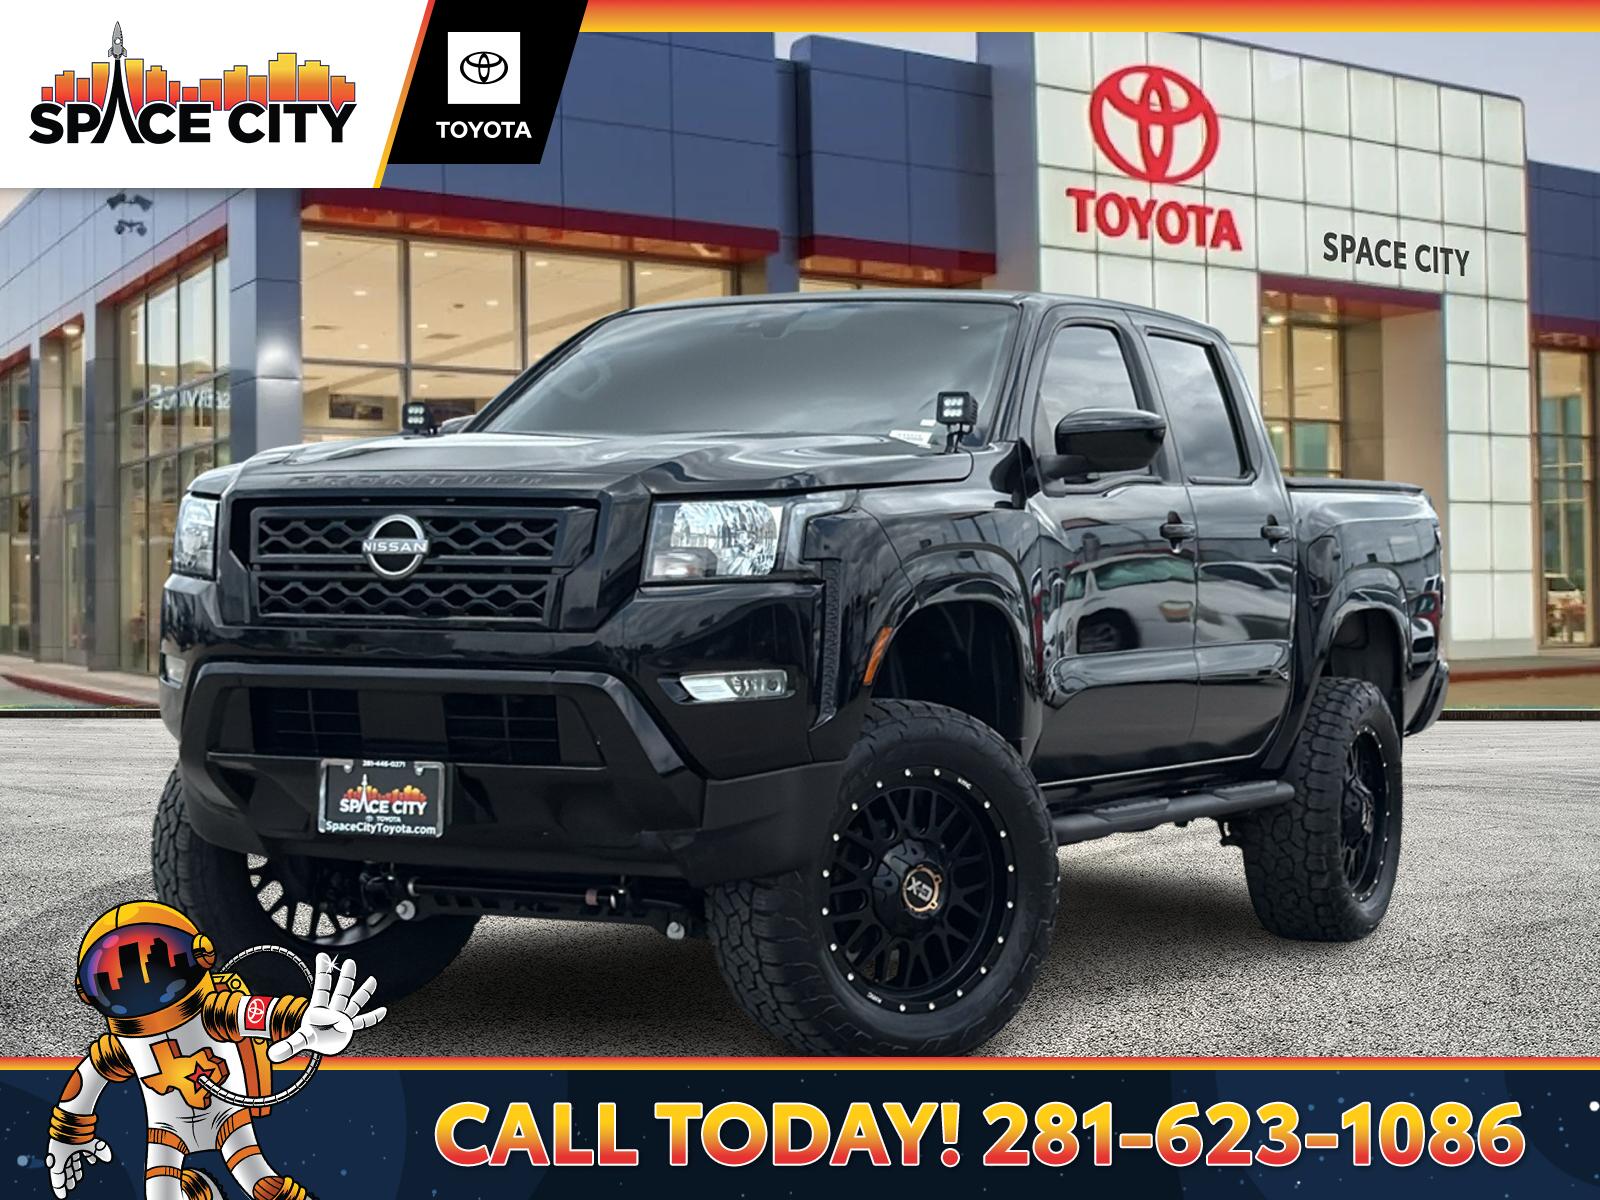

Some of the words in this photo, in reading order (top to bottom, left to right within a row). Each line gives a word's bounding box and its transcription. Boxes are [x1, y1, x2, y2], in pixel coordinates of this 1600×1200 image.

[1066, 187, 1243, 252] TOYOTA
[1323, 231, 1407, 271] SPACE
[1415, 243, 1470, 278] CITY
[363, 540, 429, 553] NISSAN
[339, 786, 390, 814] SPACE
[392, 801, 427, 815] CITY
[326, 821, 436, 835] SpaceCityToyota.com
